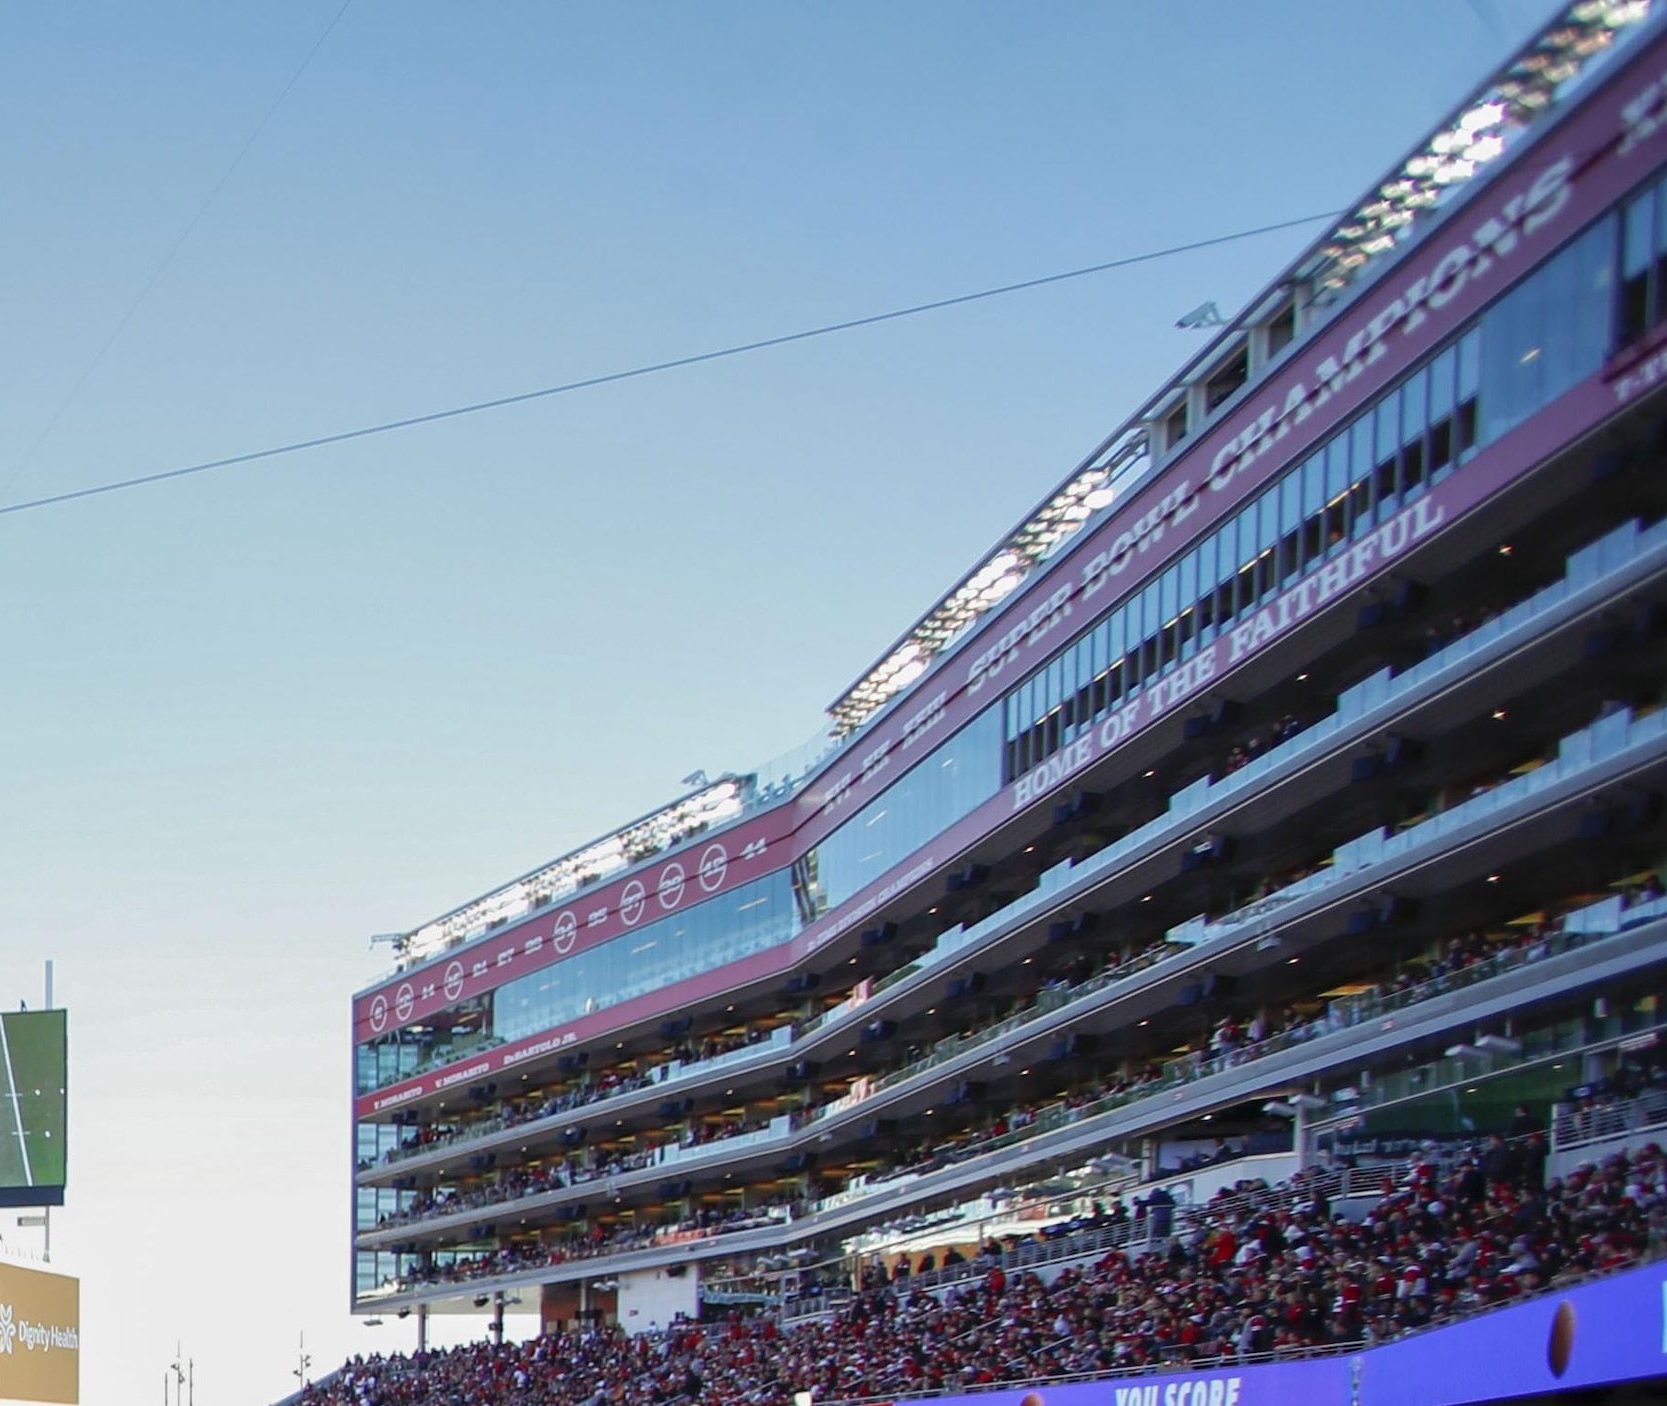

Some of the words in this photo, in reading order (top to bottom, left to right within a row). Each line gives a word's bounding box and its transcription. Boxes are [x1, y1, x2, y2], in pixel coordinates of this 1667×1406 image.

[1013, 738, 1094, 811] HOME
[1099, 698, 1142, 750] OF
[1145, 645, 1216, 718] THE
[1227, 495, 1446, 664] FAITHFUL
[18, 1320, 51, 1352] Dignity
[51, 1325, 79, 1349] Health
